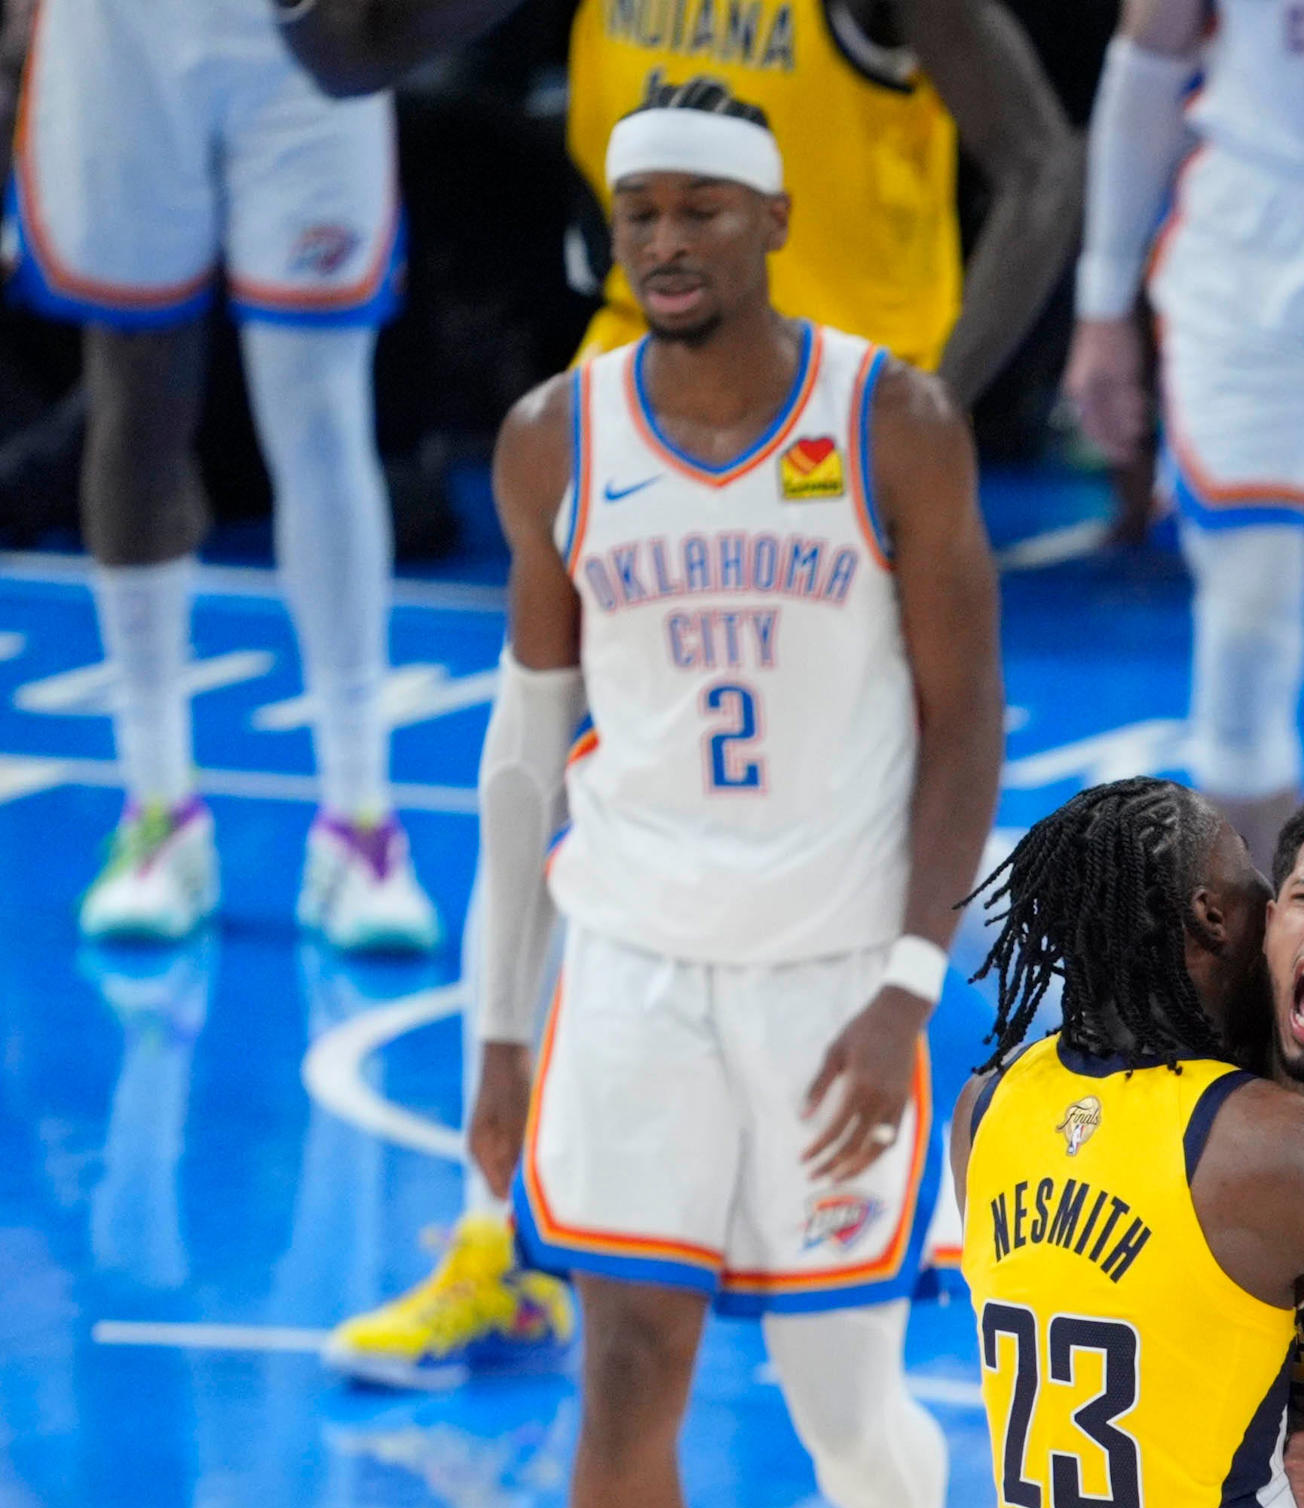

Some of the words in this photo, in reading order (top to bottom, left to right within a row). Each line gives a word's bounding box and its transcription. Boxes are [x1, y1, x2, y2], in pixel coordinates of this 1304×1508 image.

[584, 532, 860, 614] OKLAHOMA
[665, 606, 779, 672] CITY
[700, 679, 768, 795] 2
[990, 1177, 1152, 1284] NESMITH
